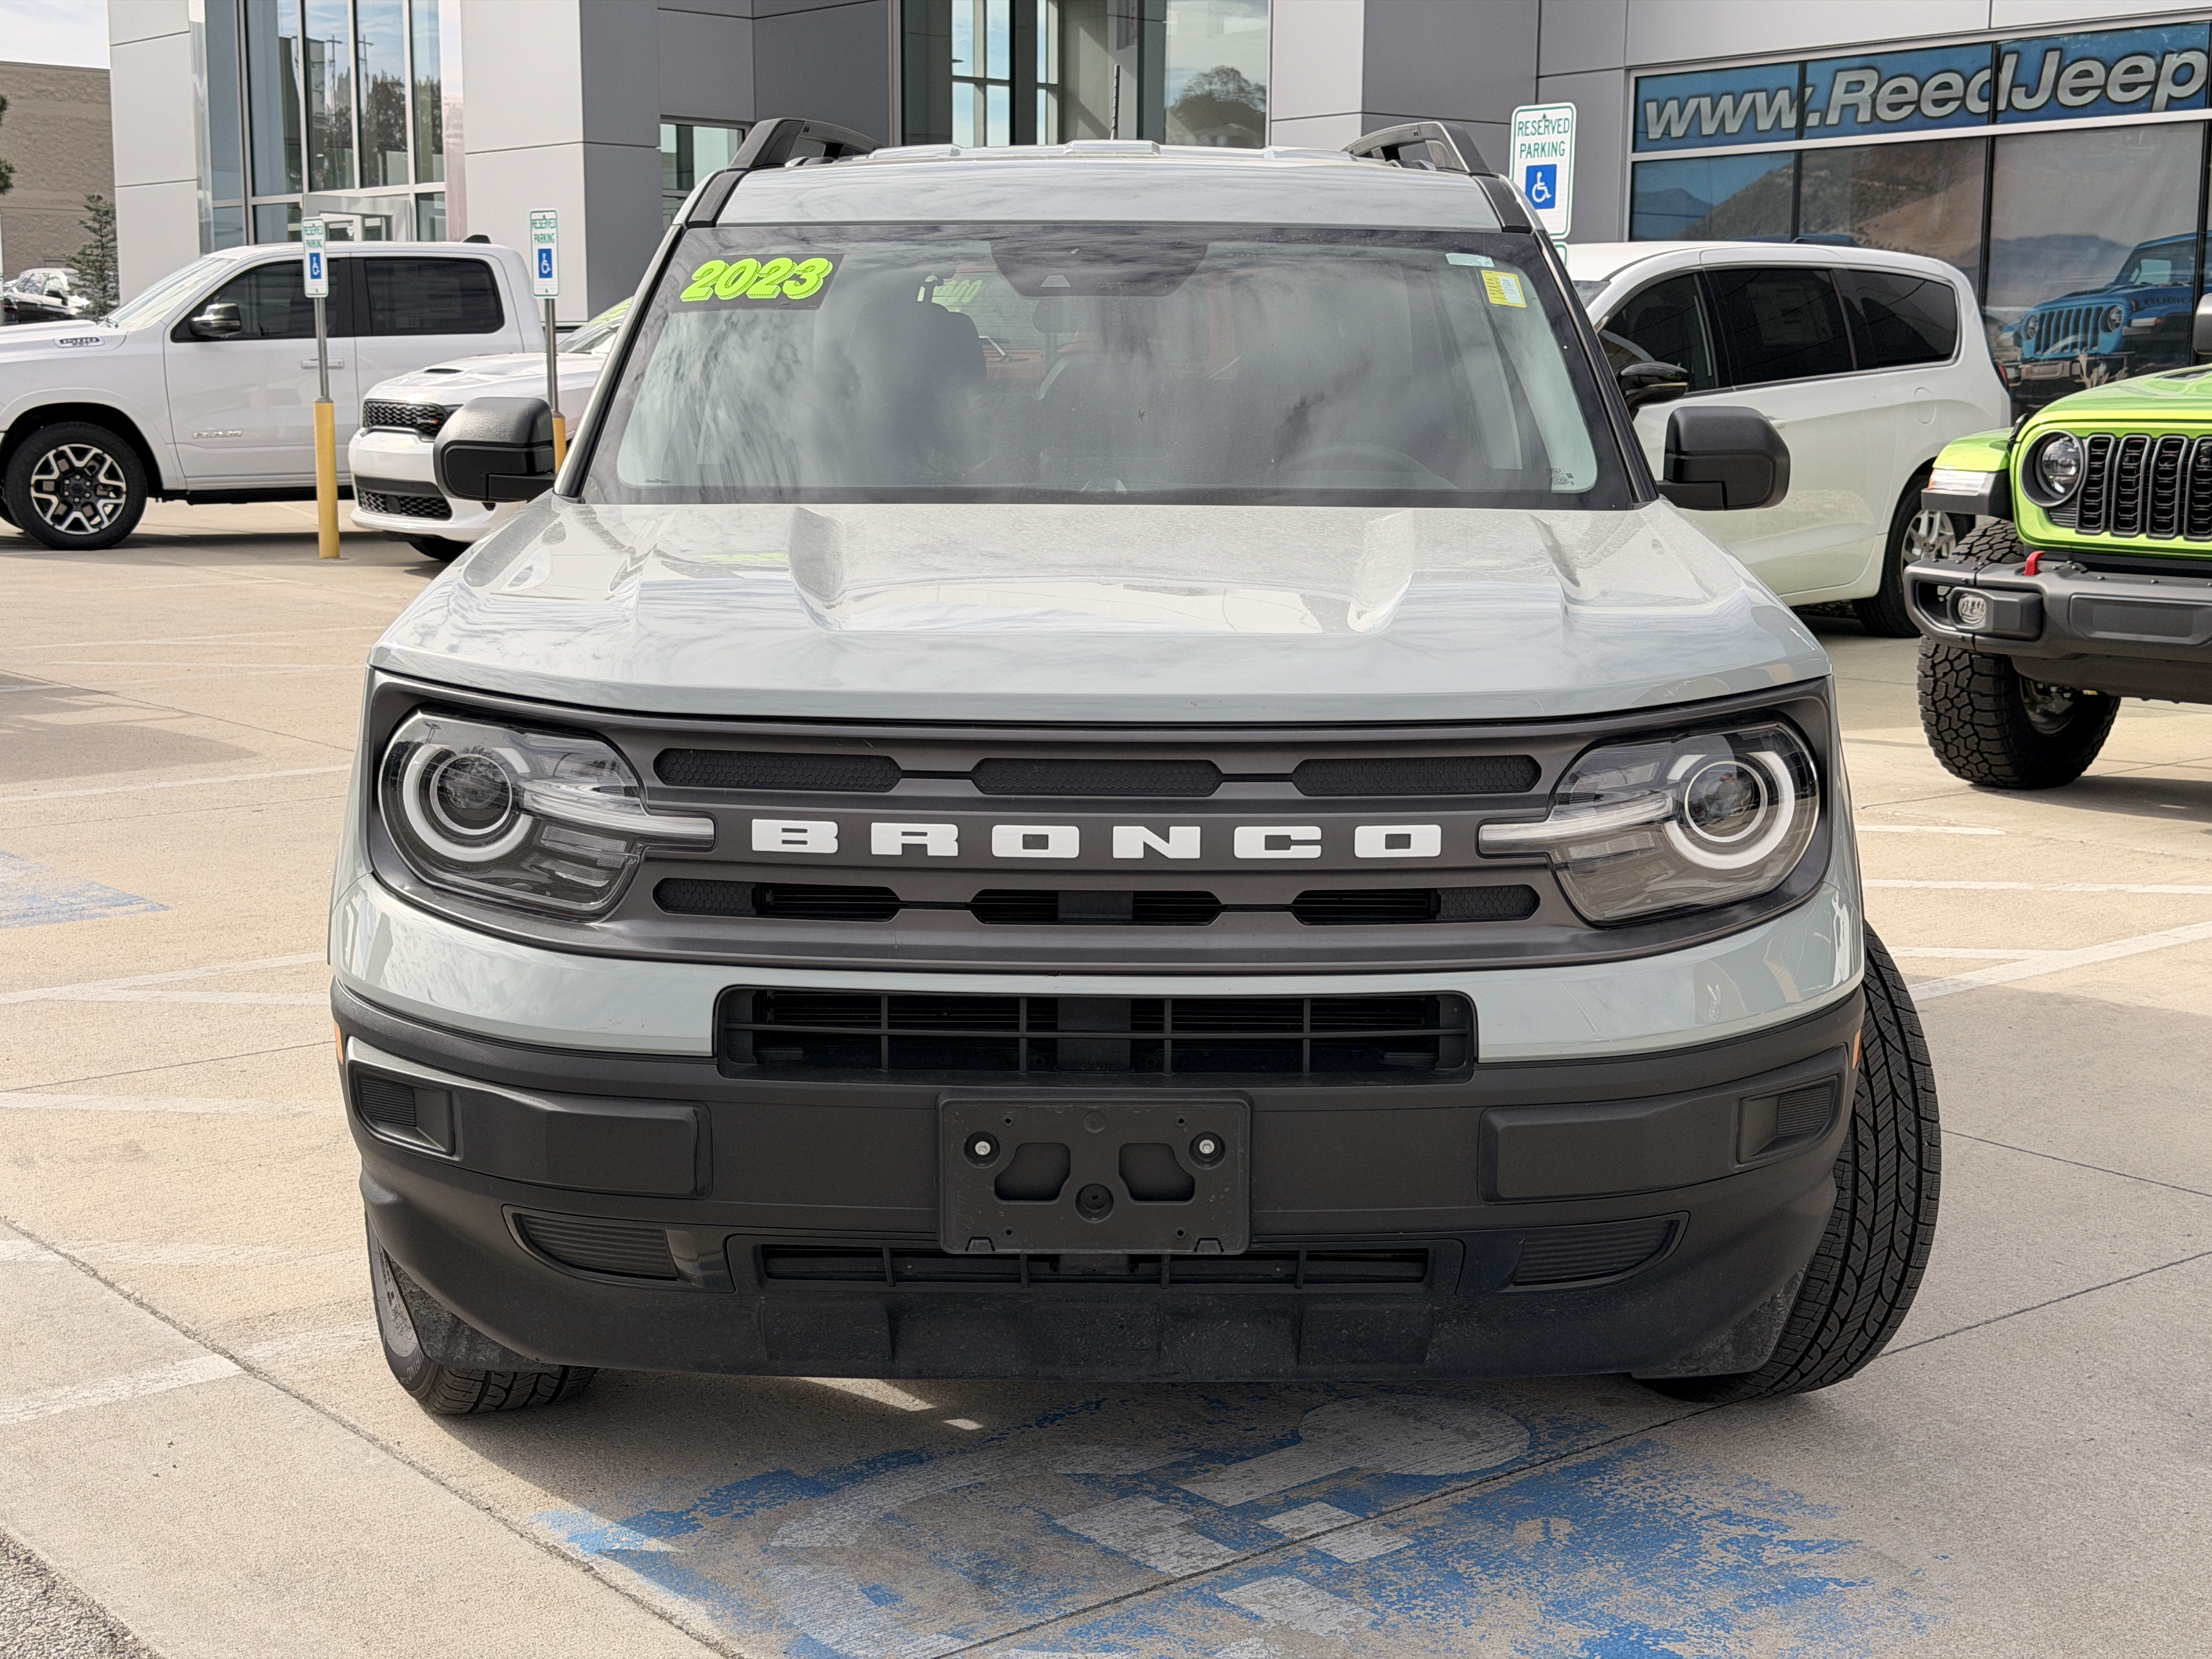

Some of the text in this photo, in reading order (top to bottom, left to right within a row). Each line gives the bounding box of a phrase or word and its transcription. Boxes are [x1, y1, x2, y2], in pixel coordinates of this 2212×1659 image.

[1517, 117, 1570, 137] RESERVED
[1519, 140, 1566, 159] PARKING
[680, 257, 833, 302] 2023
[751, 818, 1442, 859] BRONCO
